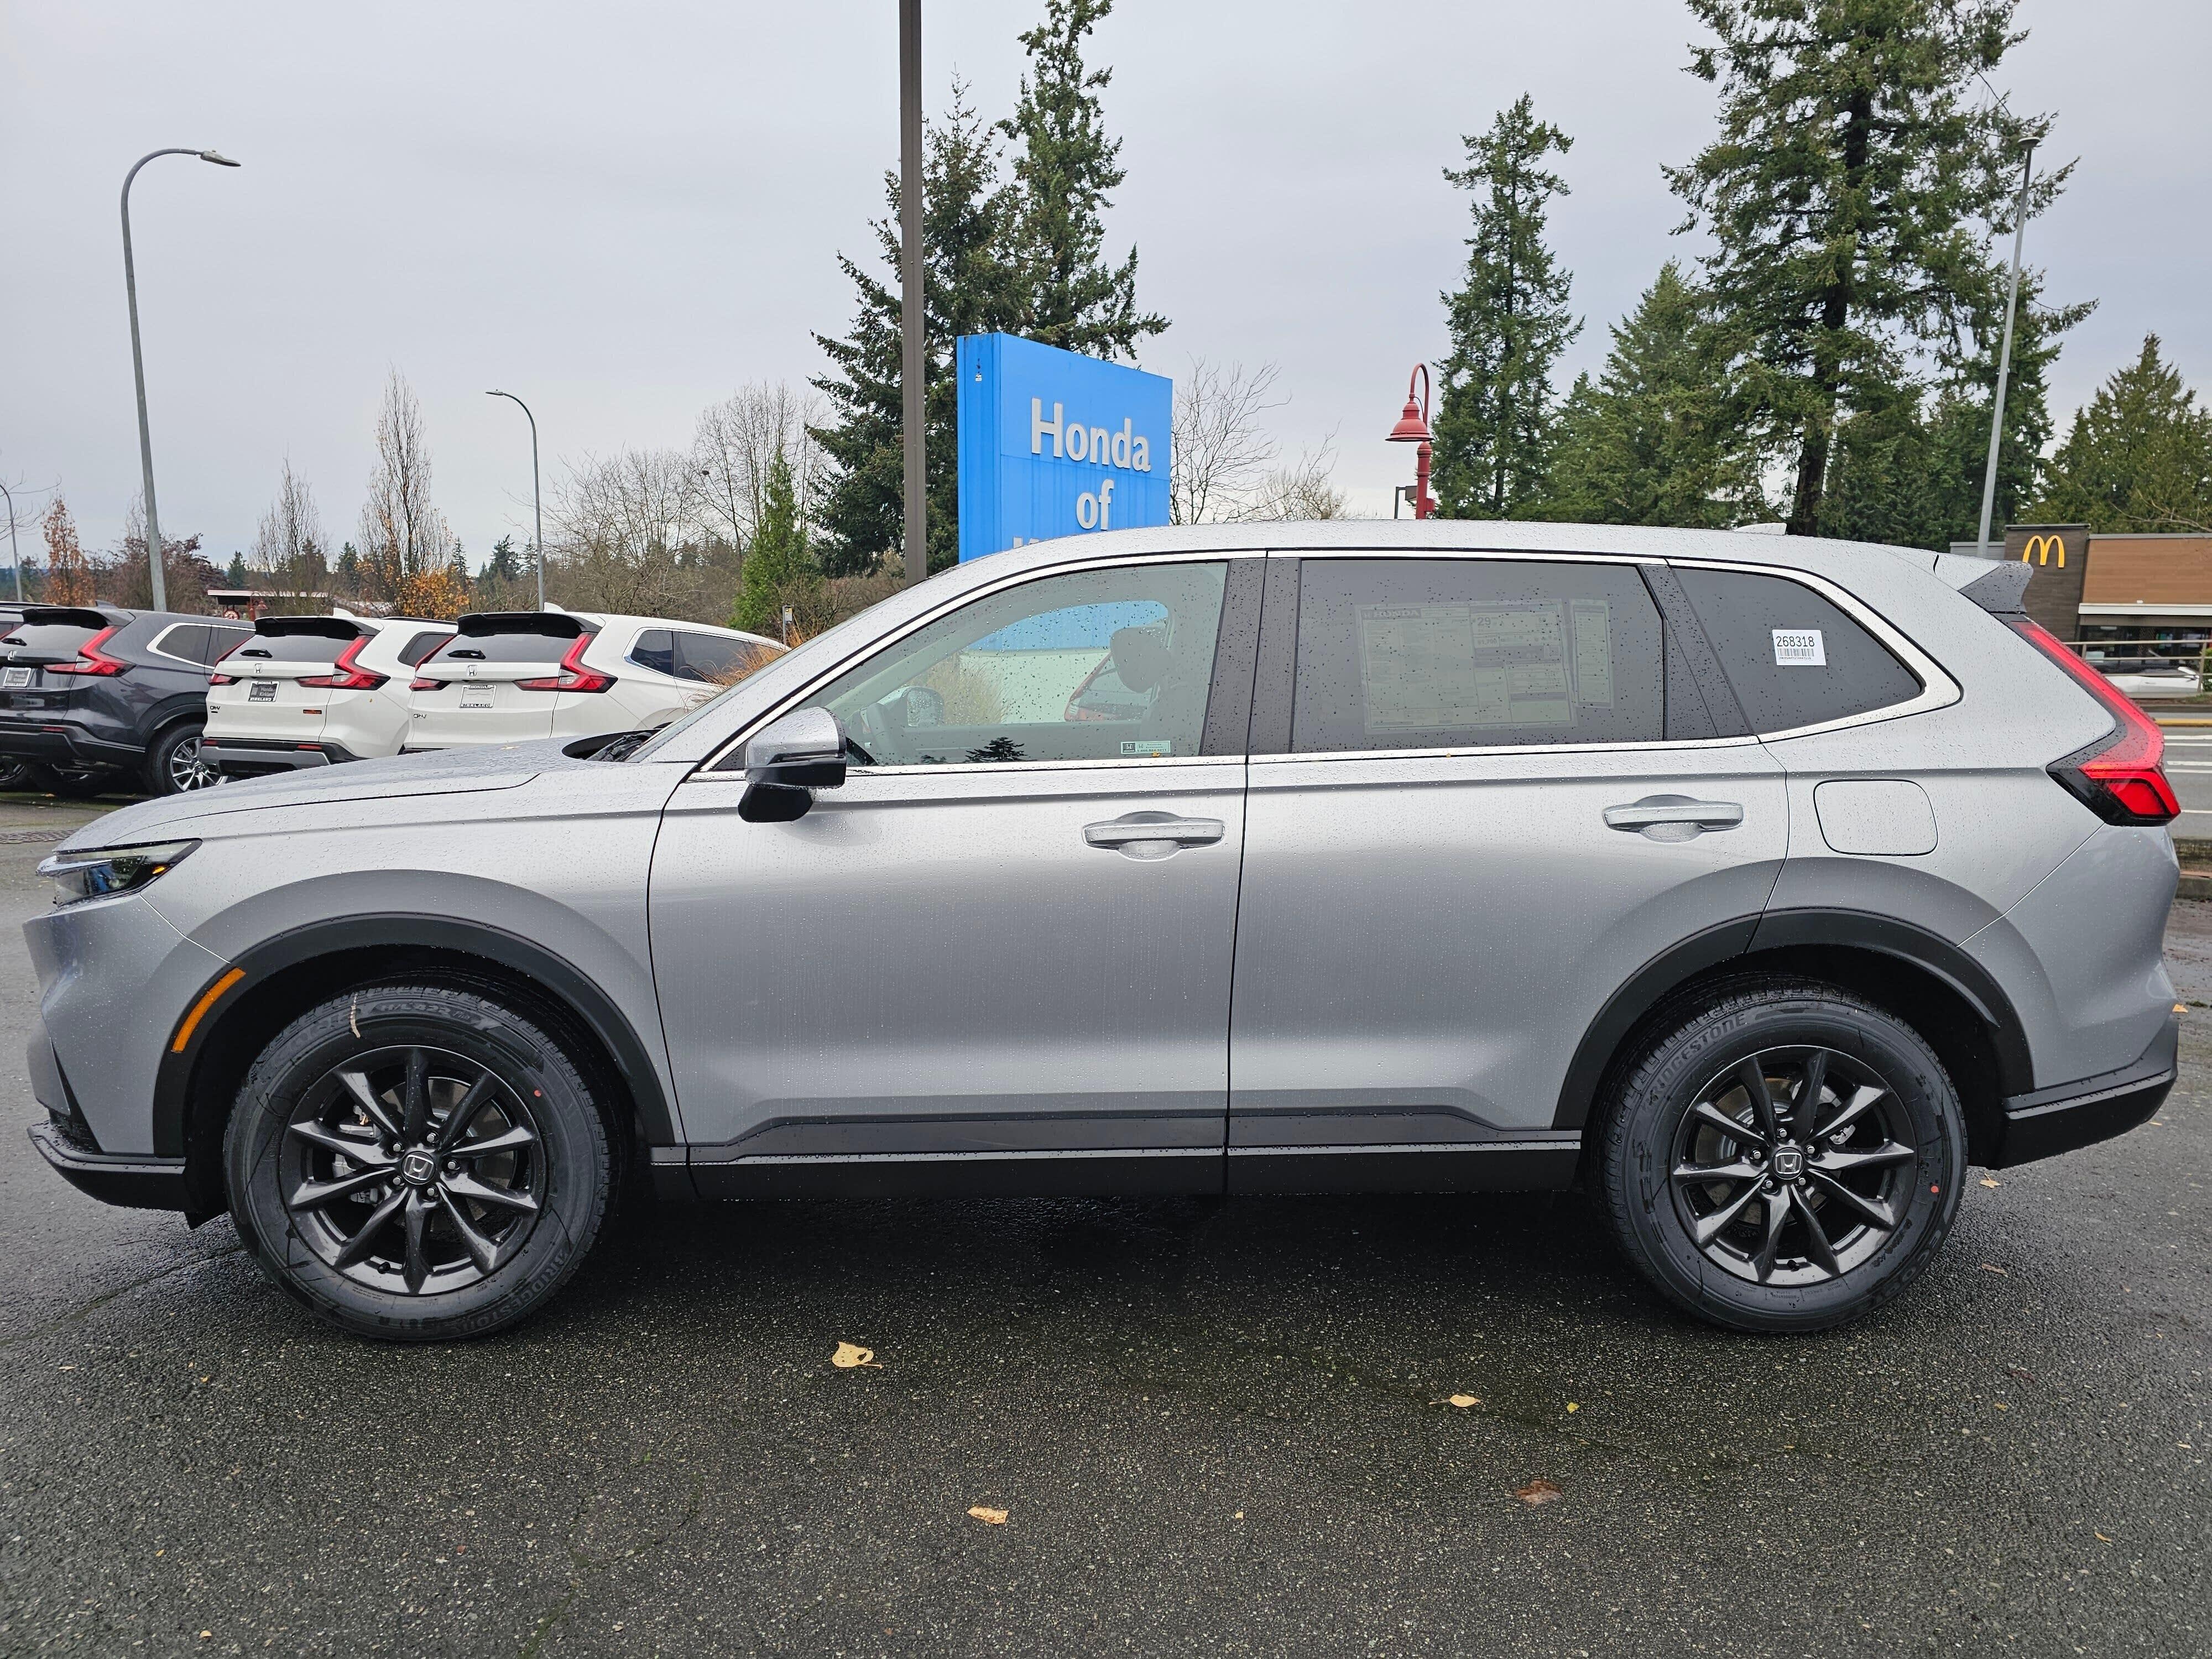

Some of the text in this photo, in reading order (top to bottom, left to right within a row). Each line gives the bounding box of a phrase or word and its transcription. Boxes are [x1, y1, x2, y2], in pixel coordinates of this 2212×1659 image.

[1031, 397, 1151, 472] Honda
[1076, 478, 1114, 530] of
[1477, 617, 1491, 626] 29
[1776, 636, 1815, 647] 268318
[1647, 1013, 1746, 1106] BRIDGESTONE
